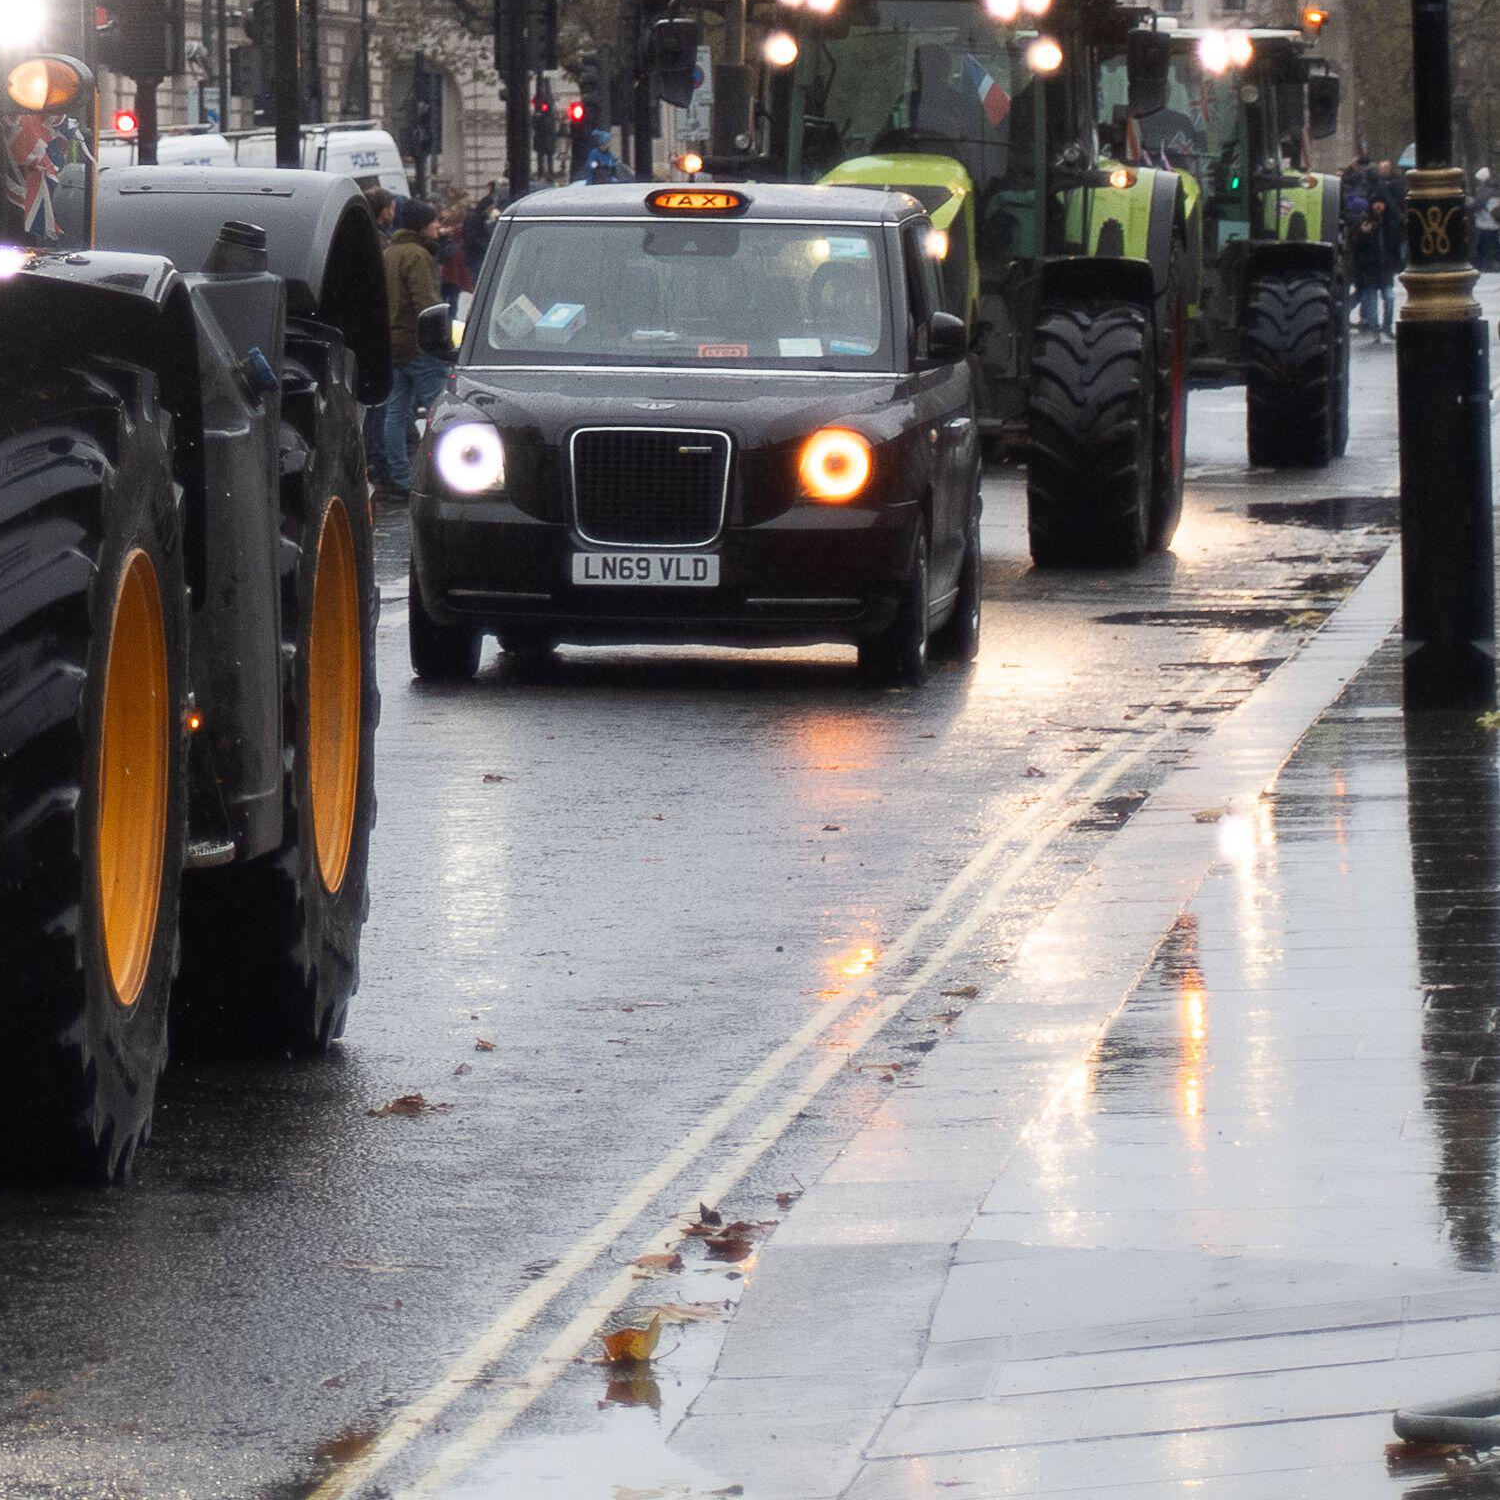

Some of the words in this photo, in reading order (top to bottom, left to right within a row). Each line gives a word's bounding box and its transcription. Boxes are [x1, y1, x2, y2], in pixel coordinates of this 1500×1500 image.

[663, 195, 731, 206] TAXI
[584, 556, 650, 580] LN69
[659, 557, 708, 581] VLD
